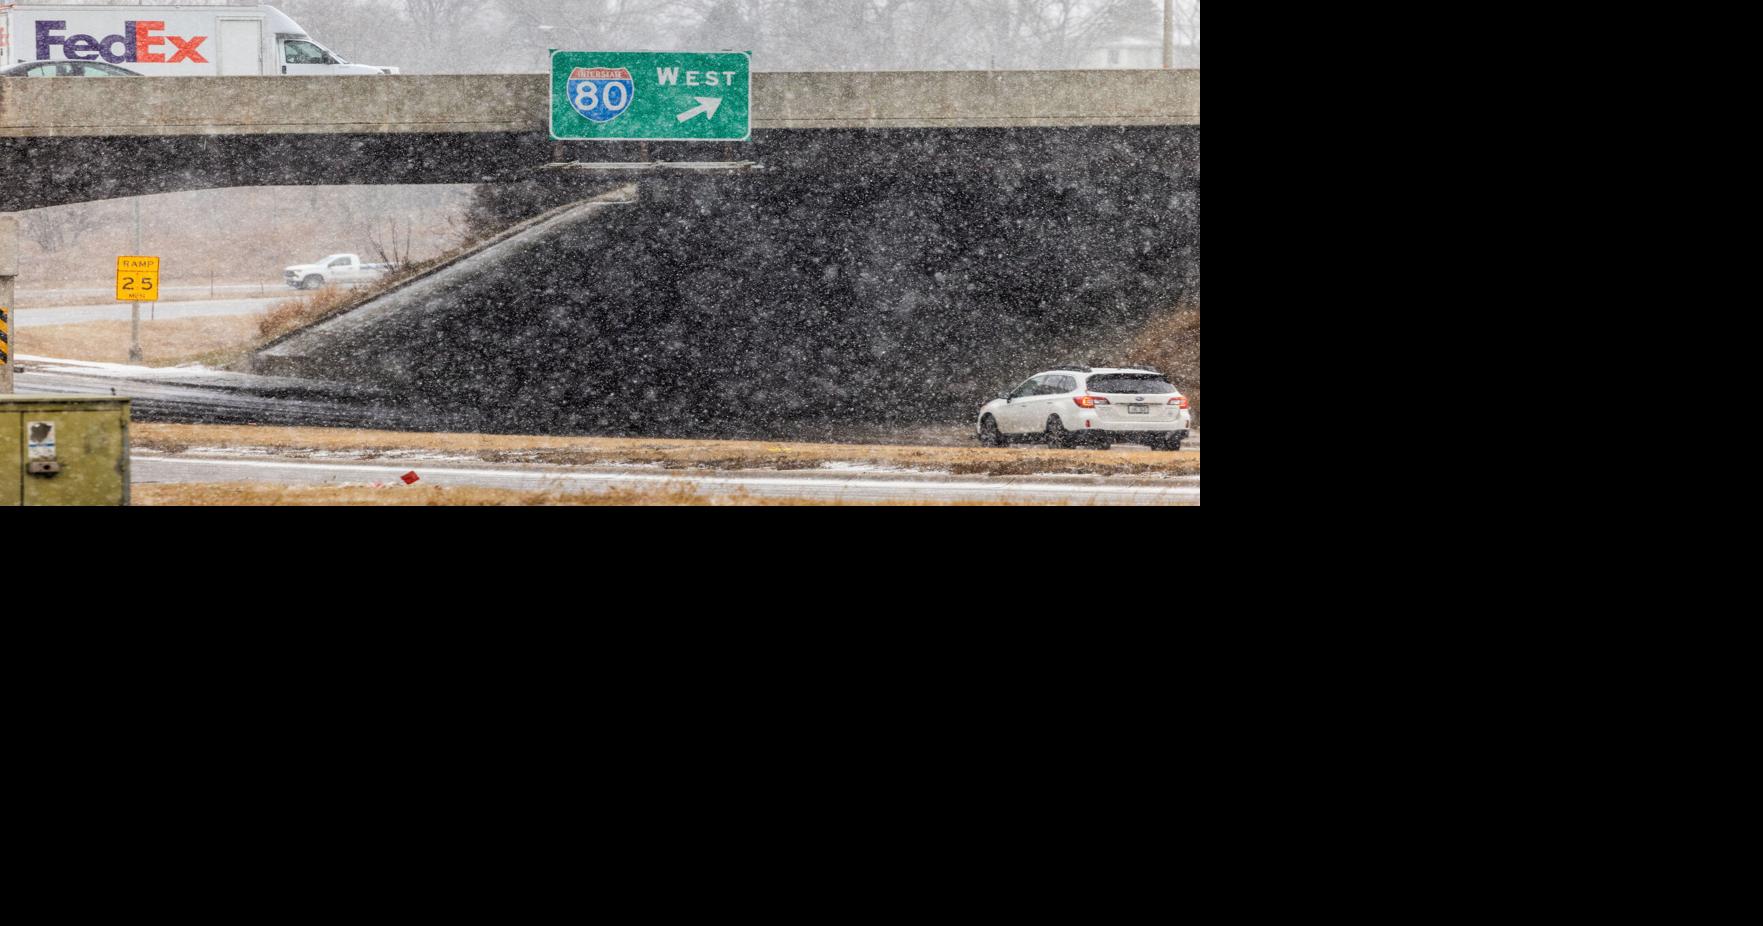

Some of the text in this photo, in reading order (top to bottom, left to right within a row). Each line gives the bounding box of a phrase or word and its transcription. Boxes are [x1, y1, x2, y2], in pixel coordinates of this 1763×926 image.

[35, 20, 209, 64] FedEx
[577, 71, 624, 79] INTERSTATE
[656, 67, 736, 86] WEST
[575, 81, 628, 111] 80
[123, 260, 154, 268] RAMP
[122, 277, 153, 290] 25
